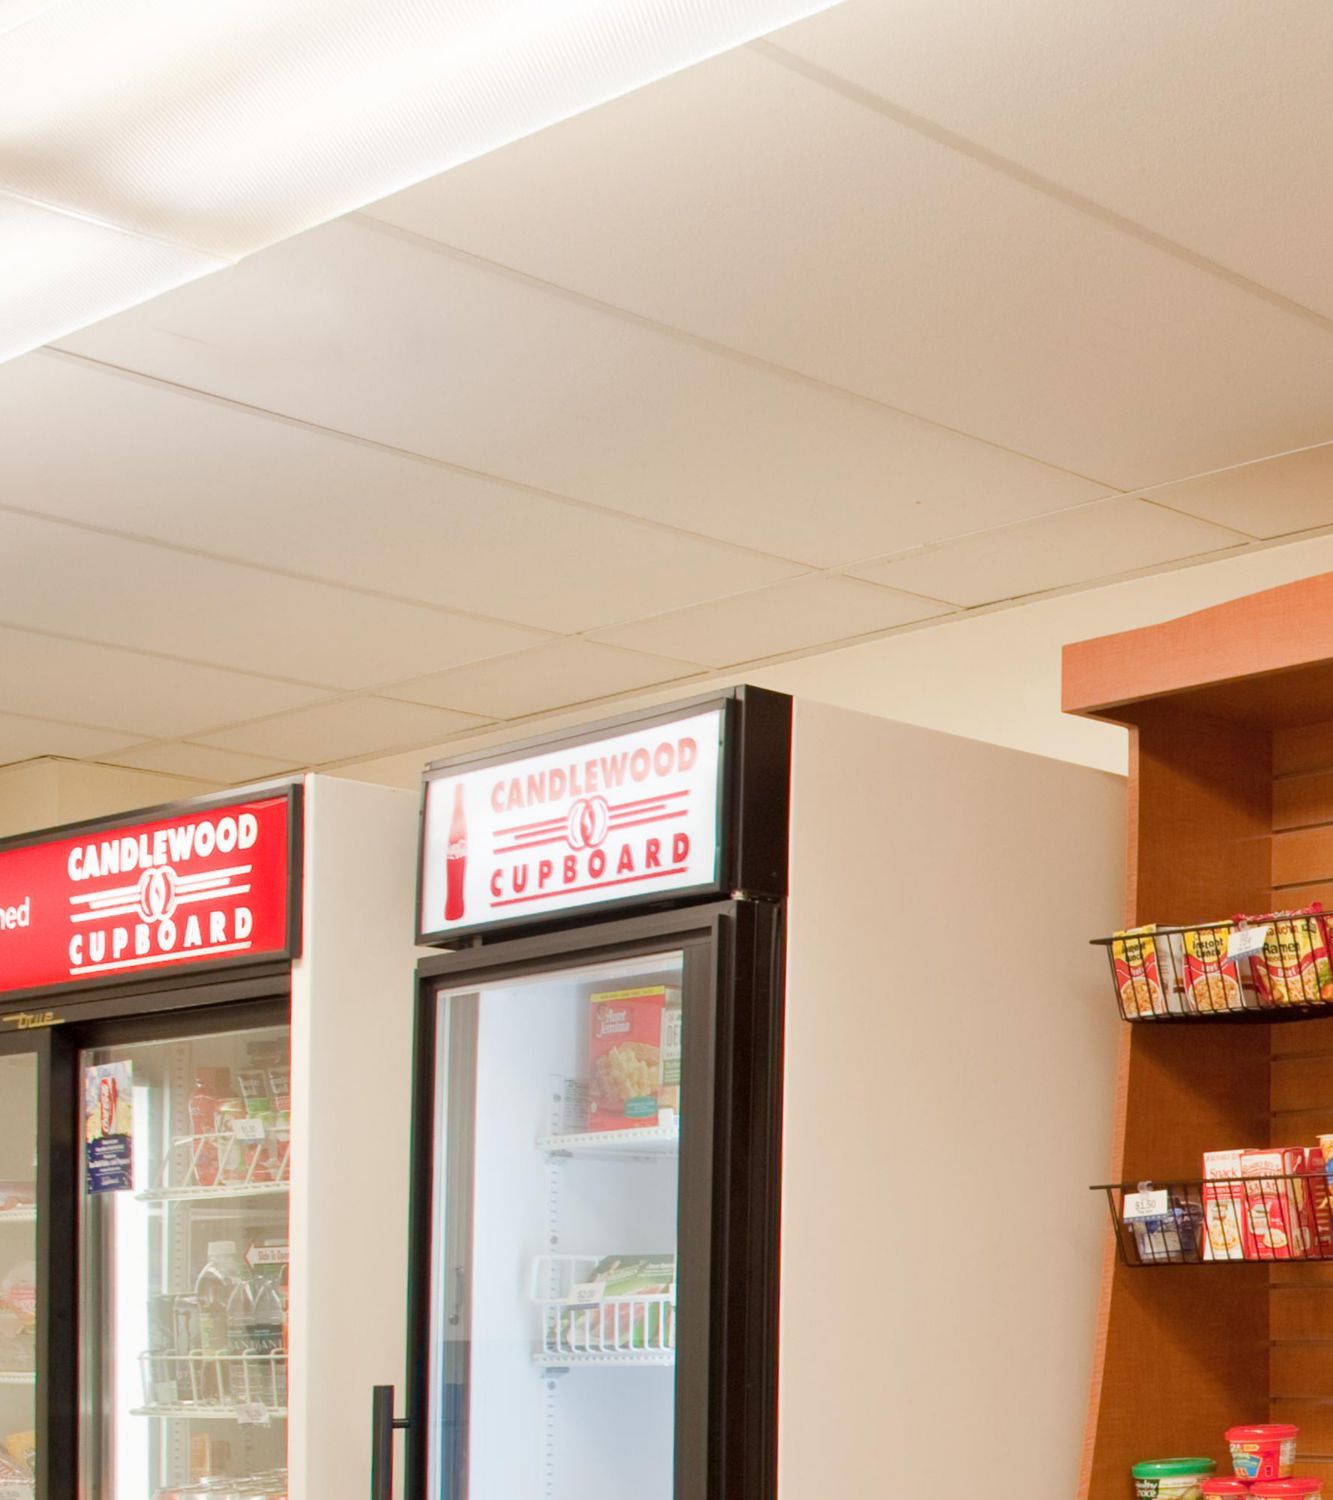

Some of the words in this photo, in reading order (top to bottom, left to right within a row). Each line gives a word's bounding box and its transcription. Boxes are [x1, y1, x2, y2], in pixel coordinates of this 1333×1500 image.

[491, 737, 697, 813] CANDLEWOOD
[67, 813, 258, 881] CANDLEWOOD
[489, 832, 691, 898] CUPBOARD
[68, 907, 253, 966] CUPBOARD
